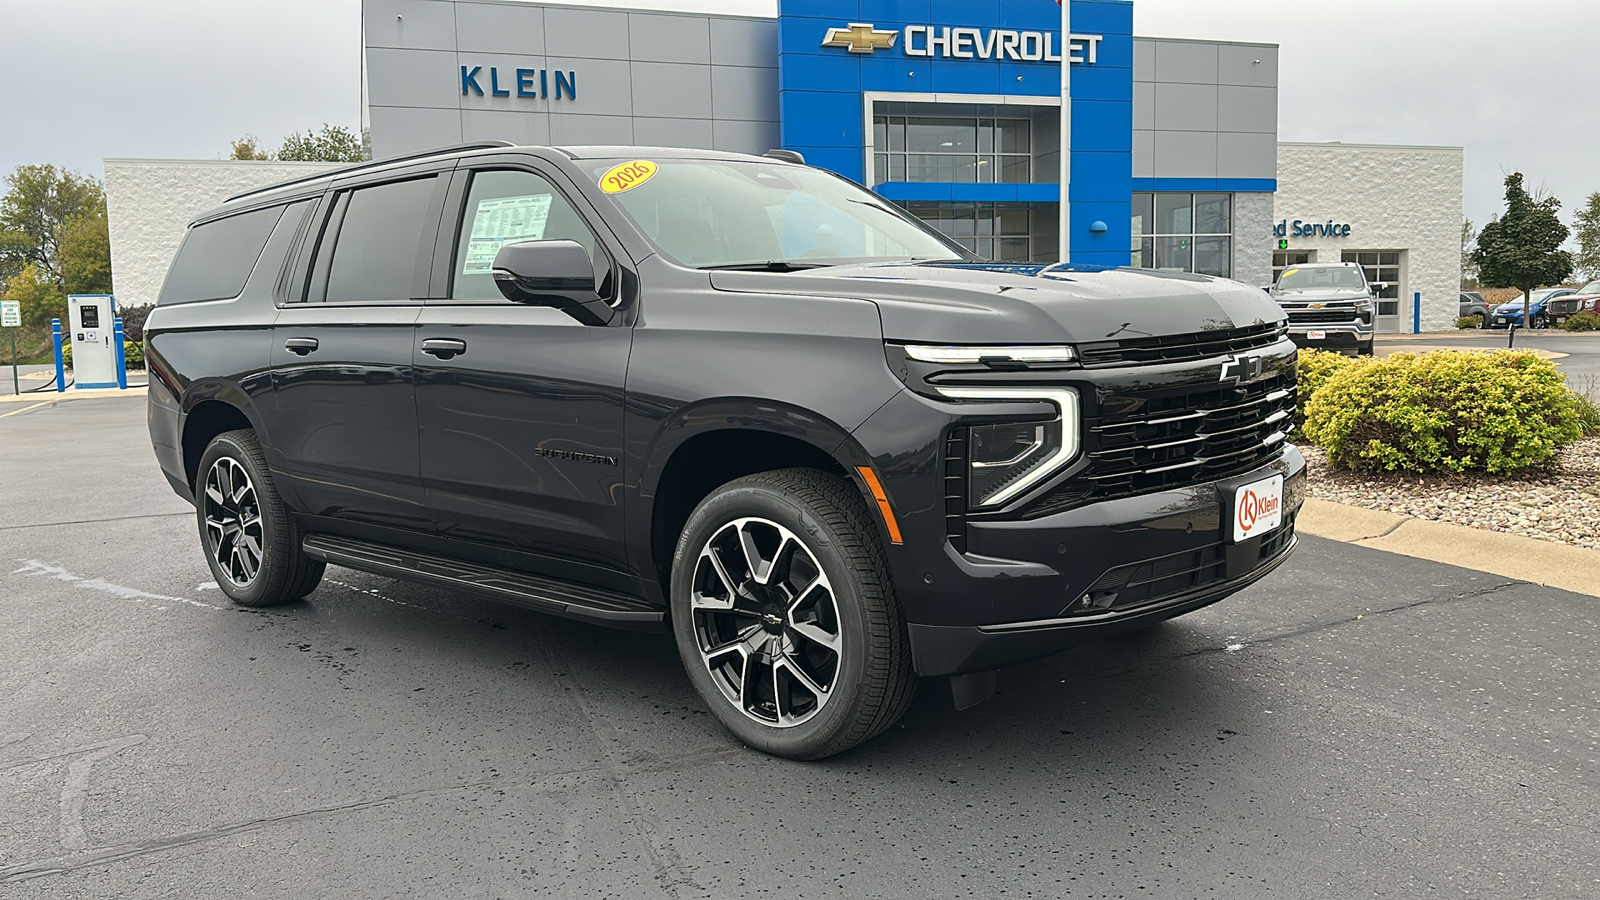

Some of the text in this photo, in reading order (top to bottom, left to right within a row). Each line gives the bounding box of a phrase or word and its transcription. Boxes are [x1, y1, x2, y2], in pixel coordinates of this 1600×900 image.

[904, 25, 1103, 63] CHEVROLET
[461, 65, 576, 100] KLEIN
[608, 162, 650, 189] 2026
[1292, 220, 1351, 237] Service
[535, 447, 619, 467] SUBURBAN
[1258, 494, 1279, 516] Klein
